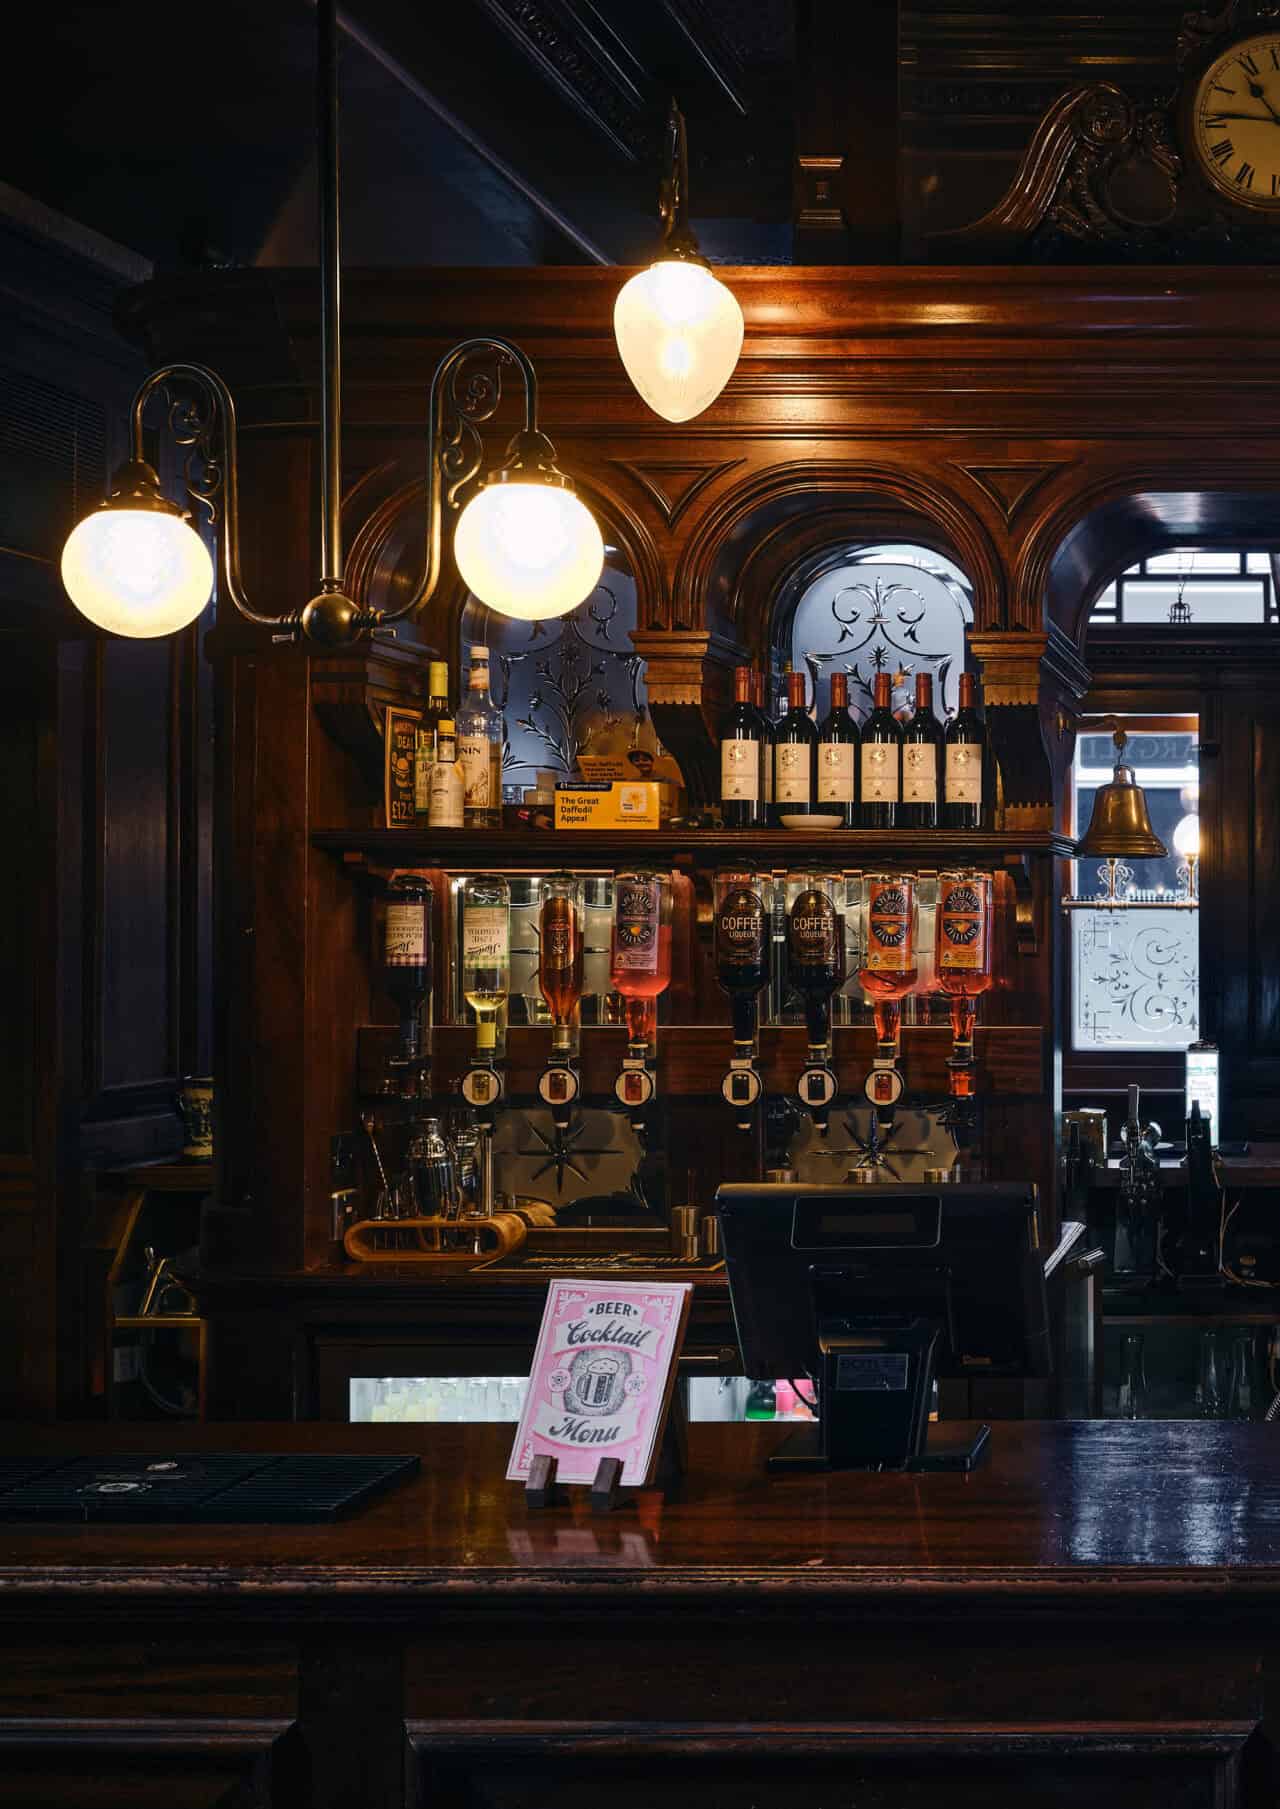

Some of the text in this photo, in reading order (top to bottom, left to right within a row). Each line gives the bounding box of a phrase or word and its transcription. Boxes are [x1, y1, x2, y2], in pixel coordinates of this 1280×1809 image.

[460, 745, 481, 755] NIN
[560, 796, 599, 805] The Great
[560, 805, 593, 813] Daffodil
[560, 814, 588, 825] Appeal
[721, 917, 764, 930] COFFEE
[793, 917, 833, 930] COFFEE
[729, 930, 757, 938] LIQUEUR
[595, 1302, 632, 1317] BEER
[567, 1319, 652, 1348] Cocktail
[549, 1416, 622, 1443] Menu
